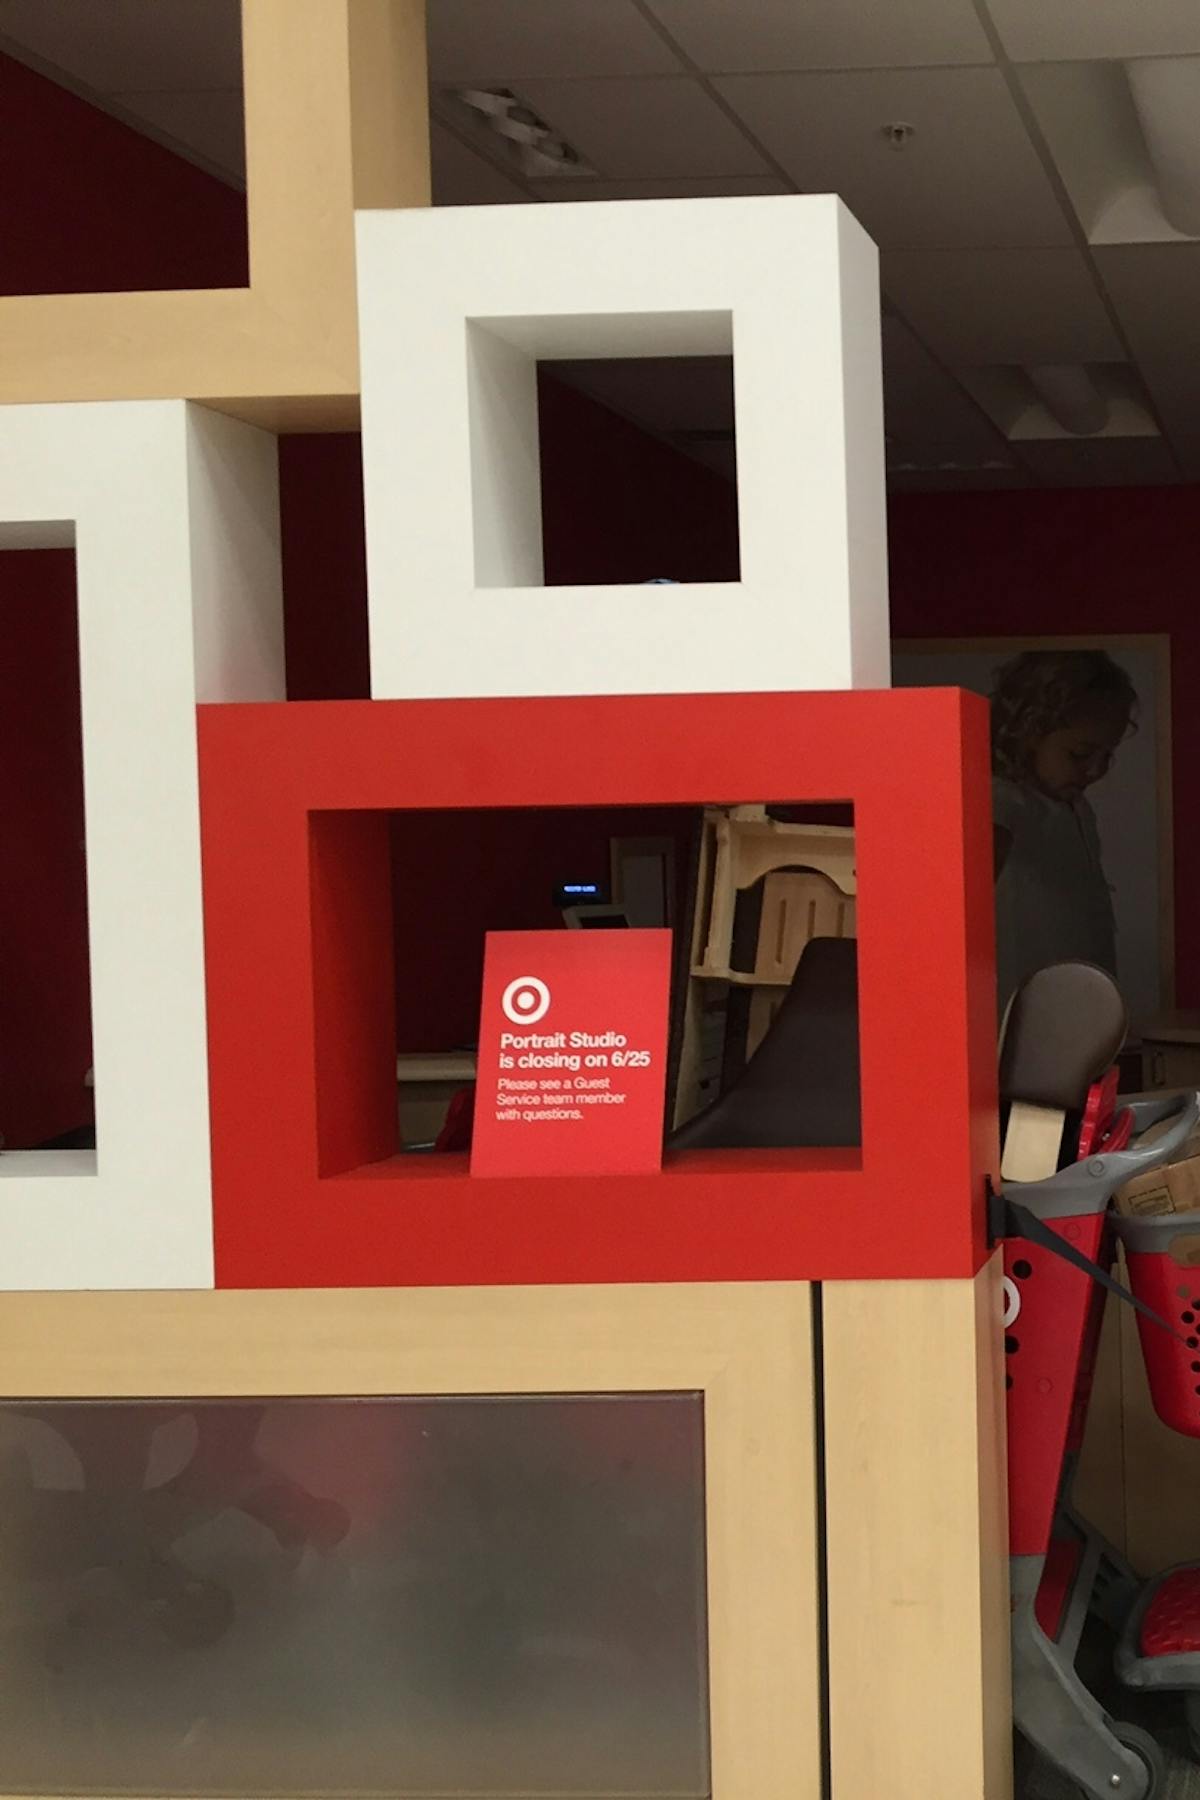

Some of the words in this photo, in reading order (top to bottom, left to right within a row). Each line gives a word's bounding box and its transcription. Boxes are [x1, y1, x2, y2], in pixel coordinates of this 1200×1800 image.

[500, 1033, 566, 1050] Portrait
[569, 1031, 627, 1049] Studio
[499, 1053, 514, 1069] is
[519, 1052, 582, 1072] closing
[584, 1056, 608, 1068] on
[610, 1050, 651, 1068] 6/25
[497, 1077, 538, 1090] Please
[539, 1079, 561, 1090] see
[563, 1079, 572, 1090] a
[573, 1076, 610, 1089] Guest
[496, 1092, 541, 1106] Service
[543, 1093, 573, 1105] team
[576, 1091, 626, 1105] member
[495, 1107, 521, 1121] with
[523, 1107, 584, 1122] questions.
